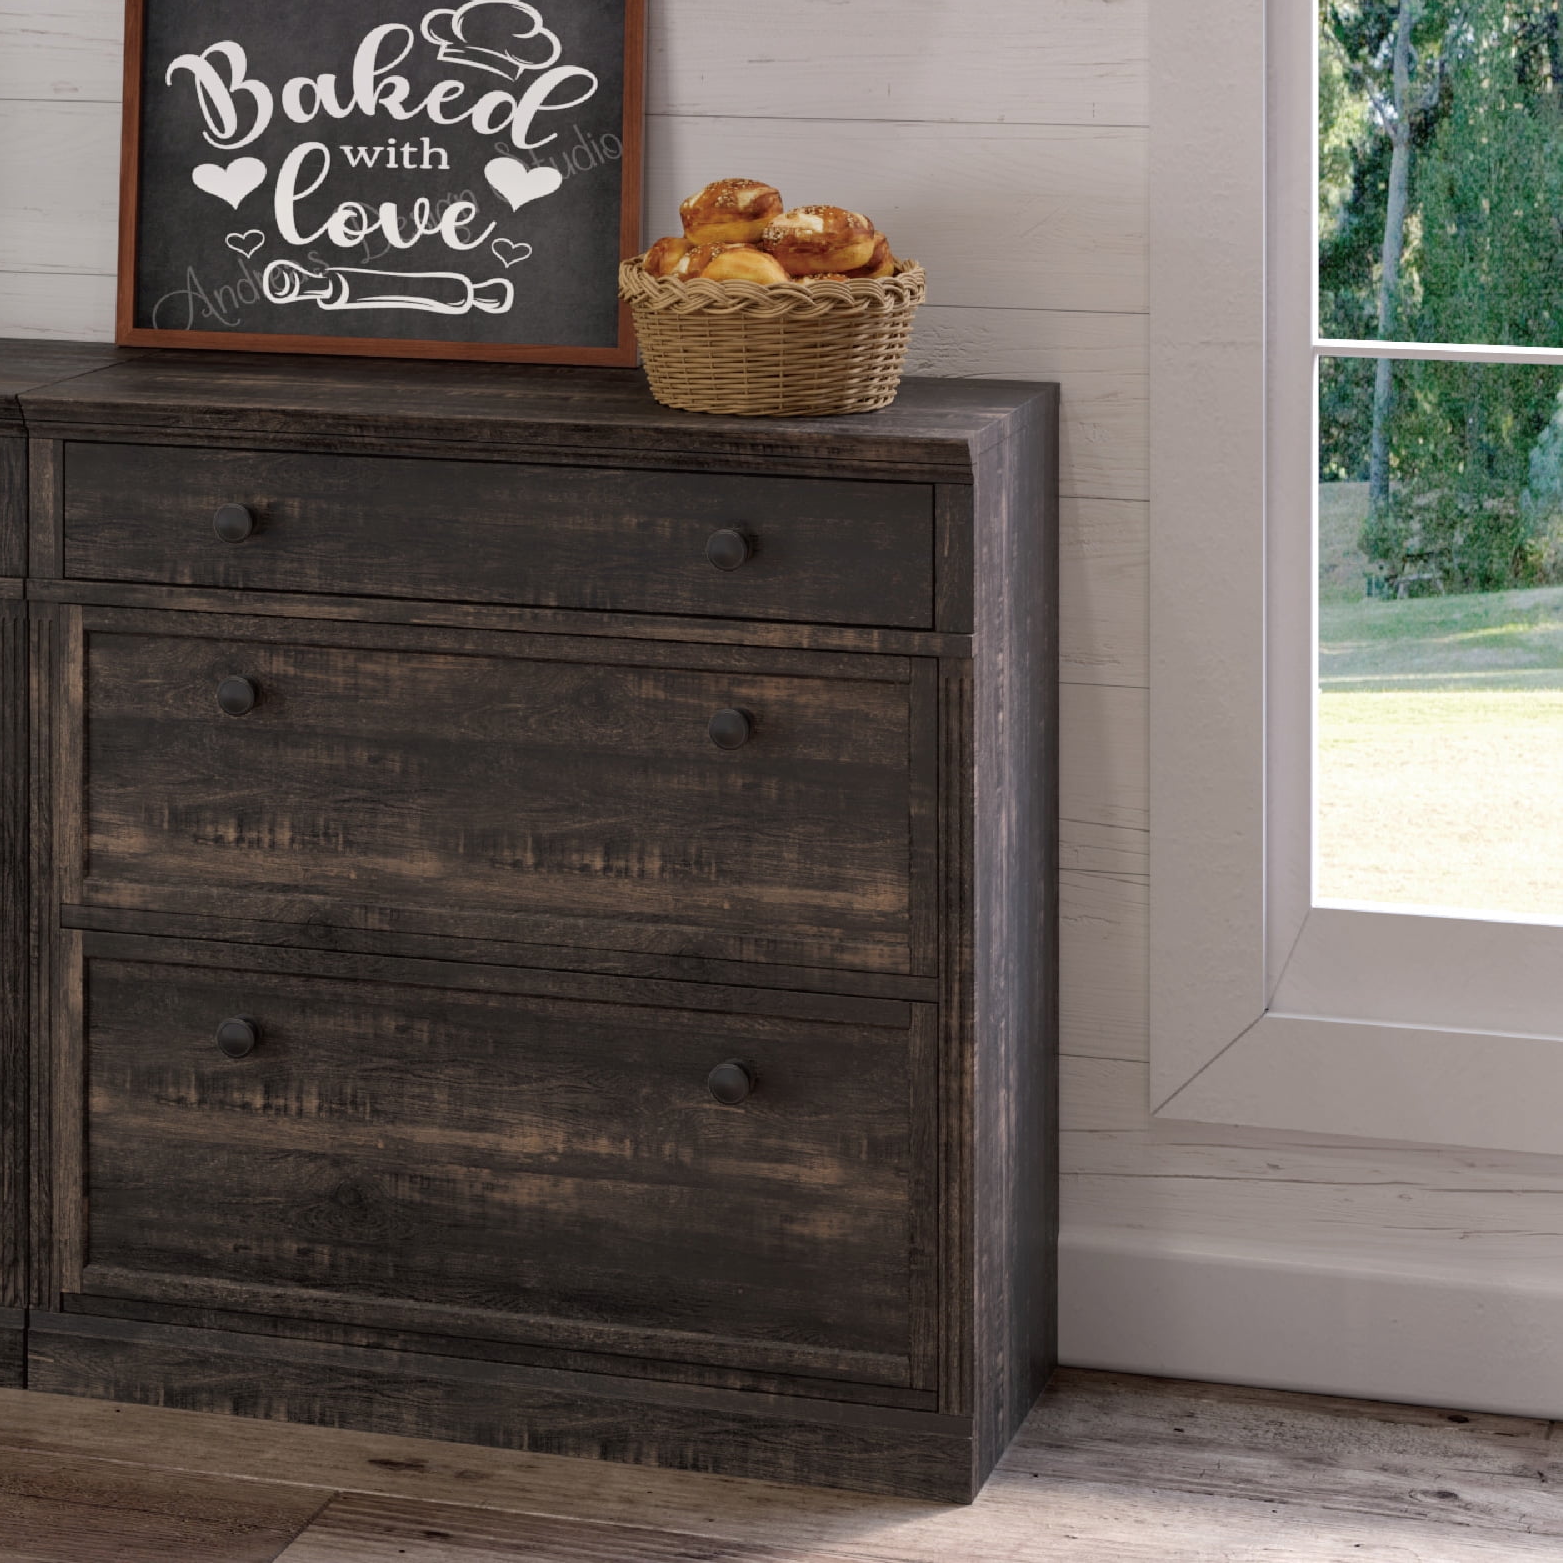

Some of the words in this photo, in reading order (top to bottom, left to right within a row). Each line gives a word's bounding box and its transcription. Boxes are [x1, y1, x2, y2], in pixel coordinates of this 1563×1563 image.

[165, 23, 598, 150] Baked
[274, 141, 497, 251] love
[339, 137, 450, 171] with
